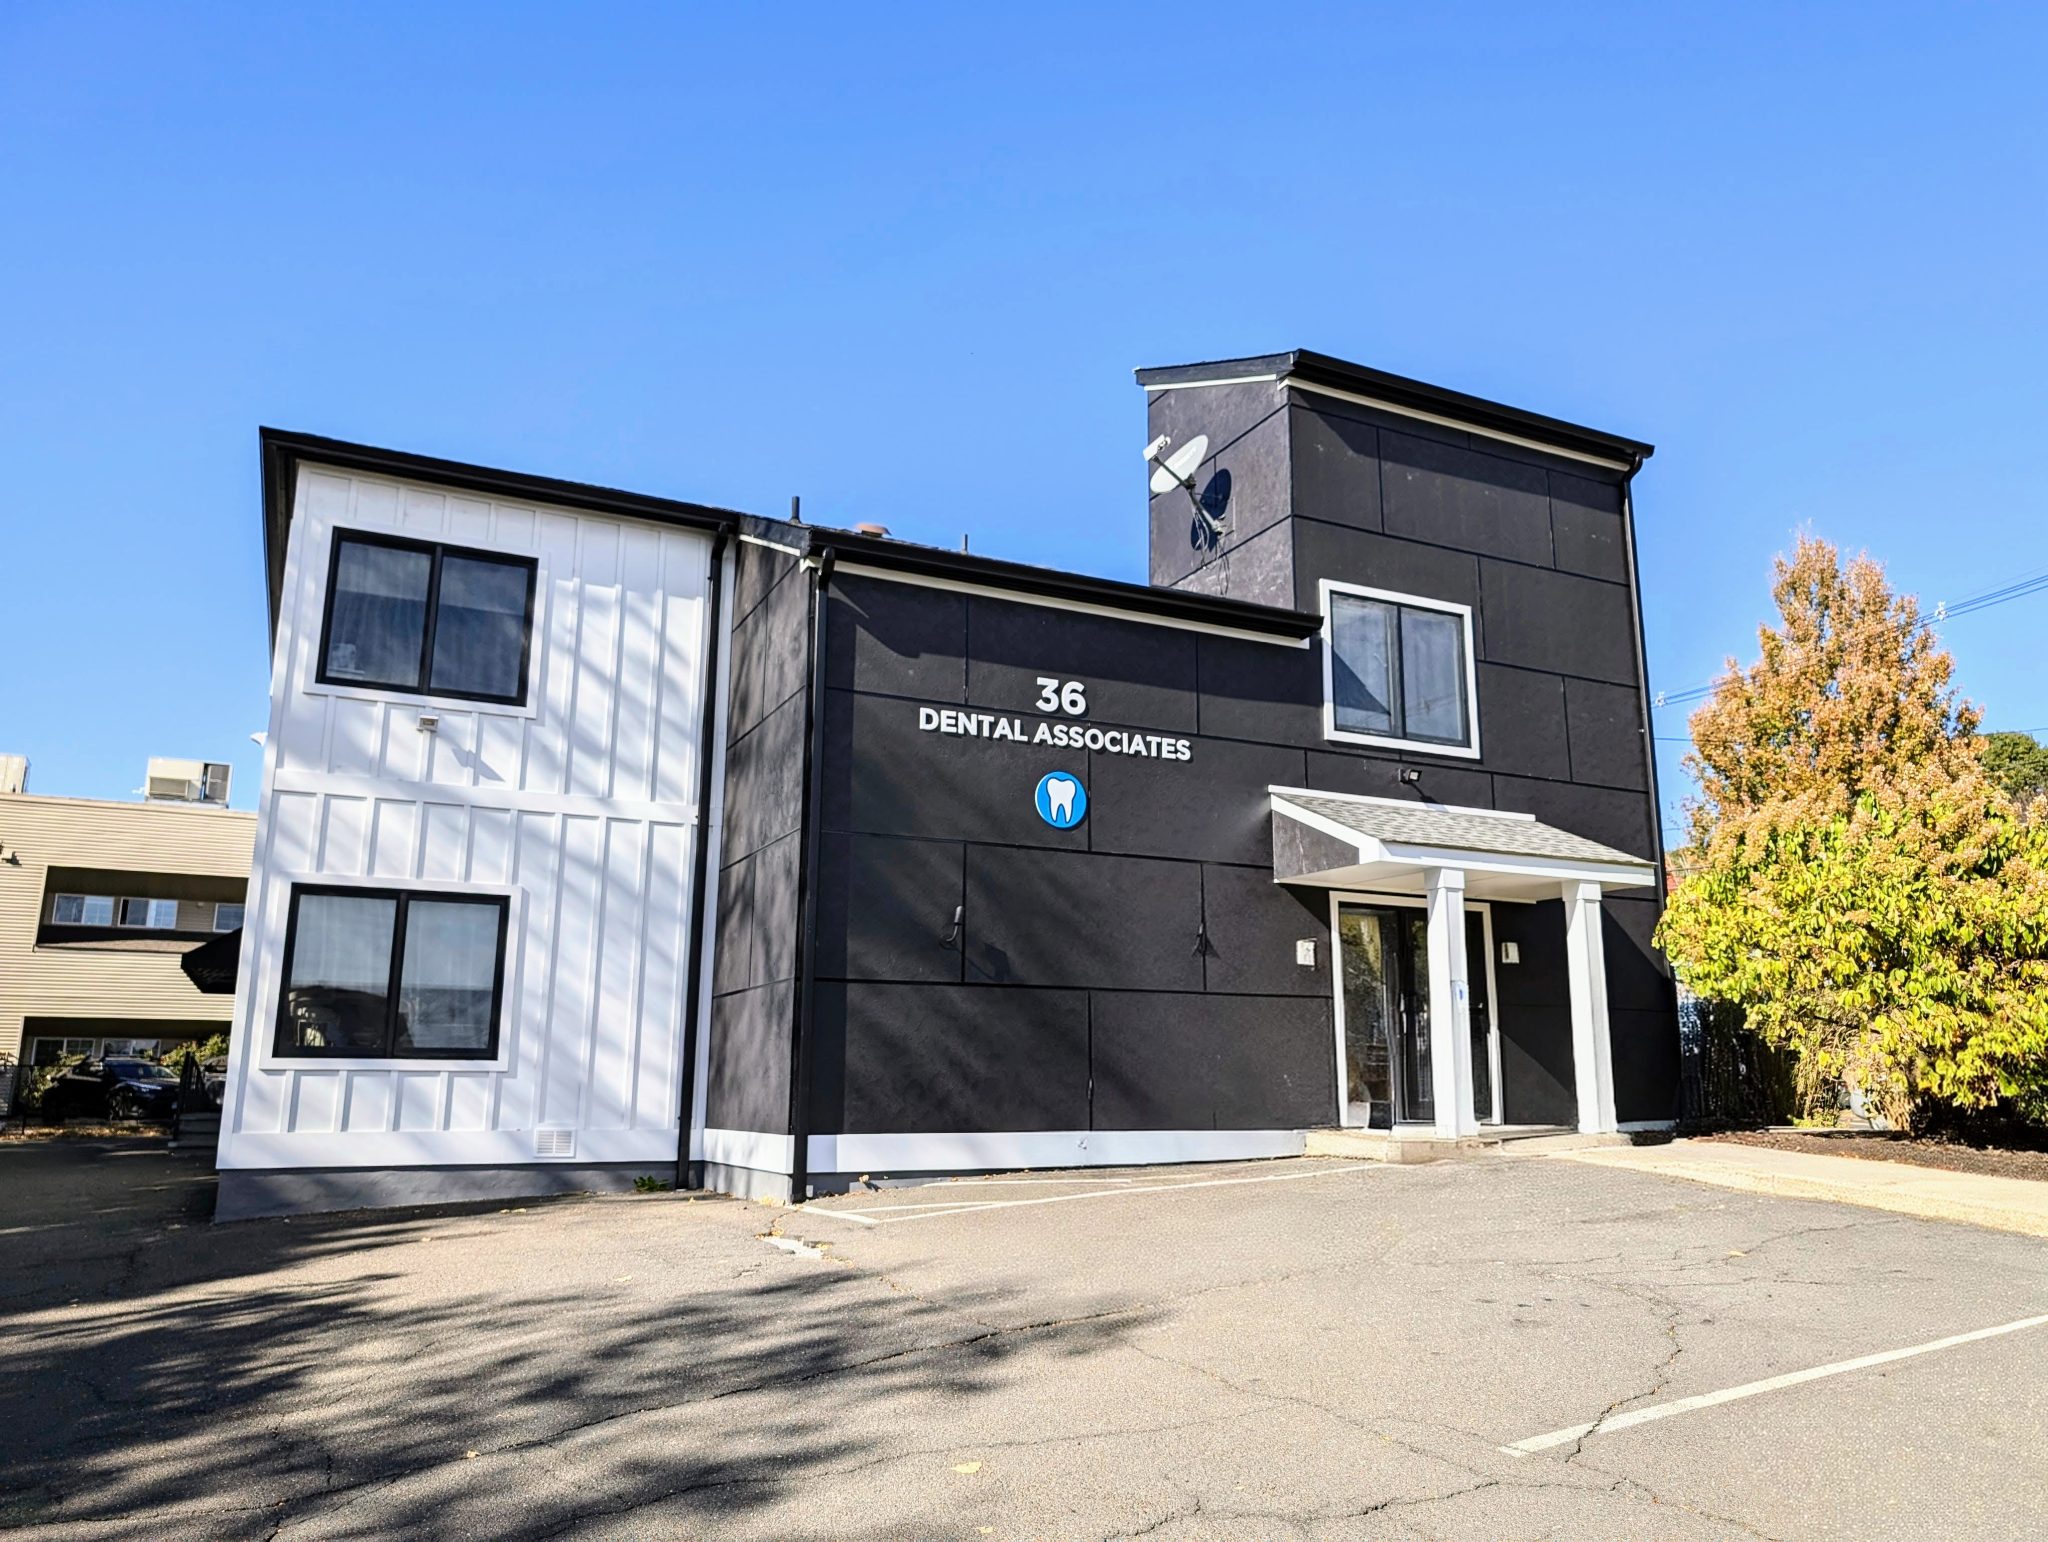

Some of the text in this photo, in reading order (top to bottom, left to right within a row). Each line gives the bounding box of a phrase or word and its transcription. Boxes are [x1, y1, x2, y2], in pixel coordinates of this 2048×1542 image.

[1035, 677, 1087, 715] 36
[918, 707, 1191, 761] DENTAL ASSOCIATES
